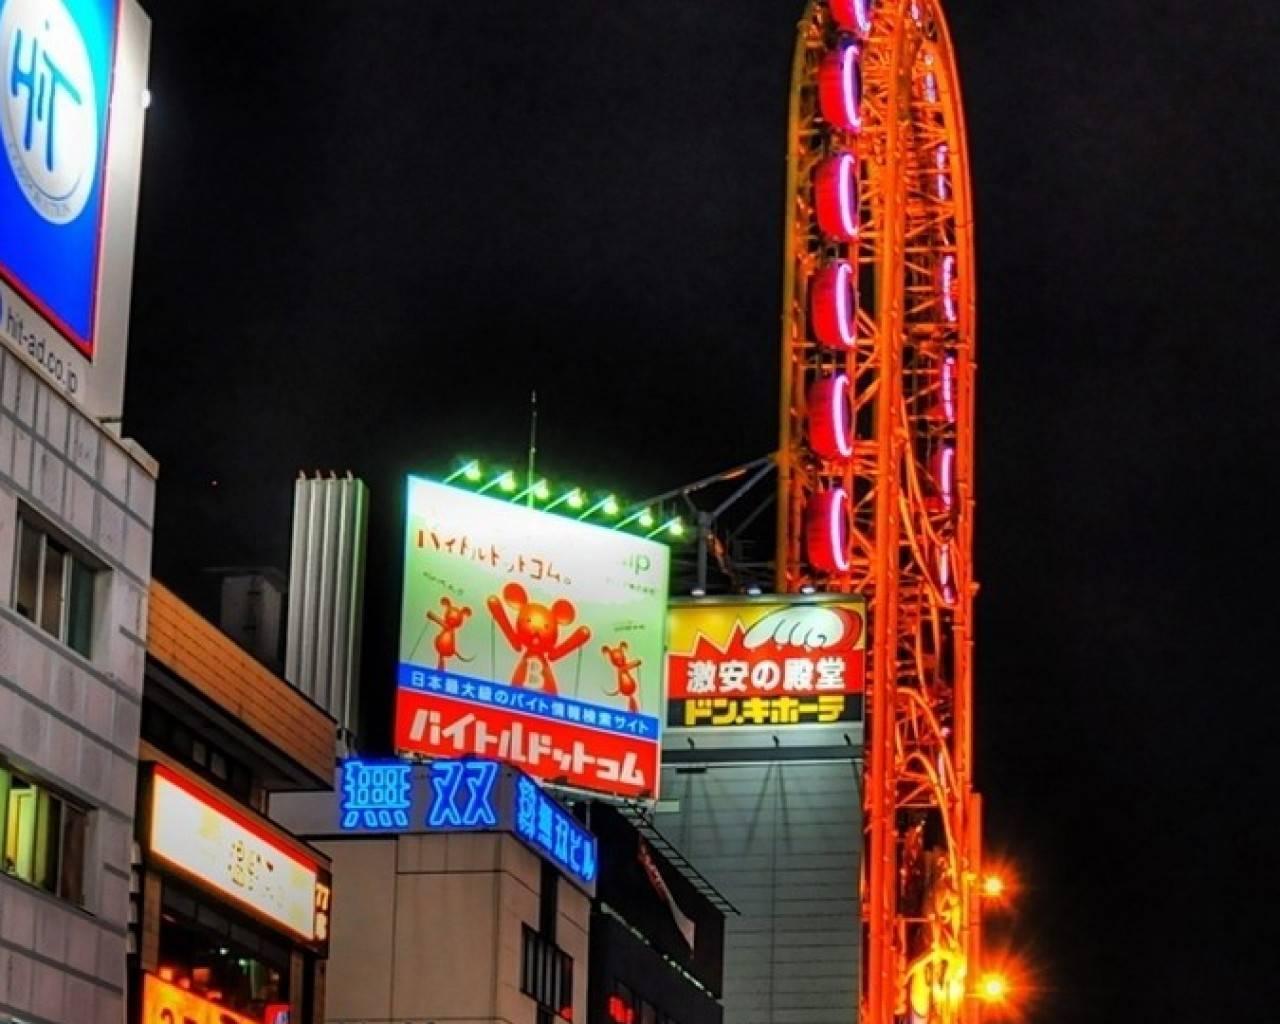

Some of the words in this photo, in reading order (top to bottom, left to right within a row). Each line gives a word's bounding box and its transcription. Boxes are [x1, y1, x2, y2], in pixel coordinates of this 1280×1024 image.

[686, 656, 845, 692] 激安の殿堂
[409, 707, 645, 787] バイトルドットコム
